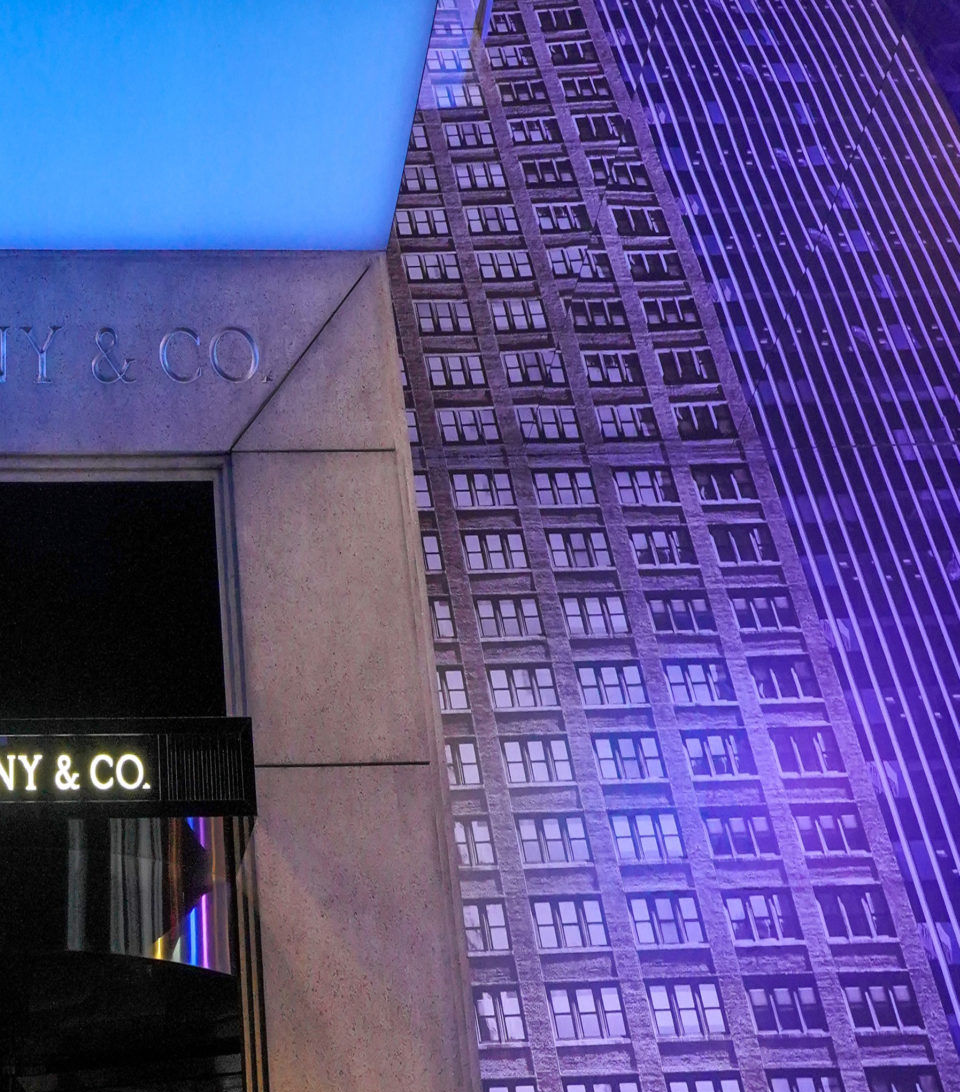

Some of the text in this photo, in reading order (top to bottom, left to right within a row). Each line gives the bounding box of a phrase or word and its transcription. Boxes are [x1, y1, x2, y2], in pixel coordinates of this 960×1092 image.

[91, 327, 138, 385] &
[158, 326, 273, 385] CO.
[54, 753, 80, 791] &
[89, 753, 151, 791] CO.
